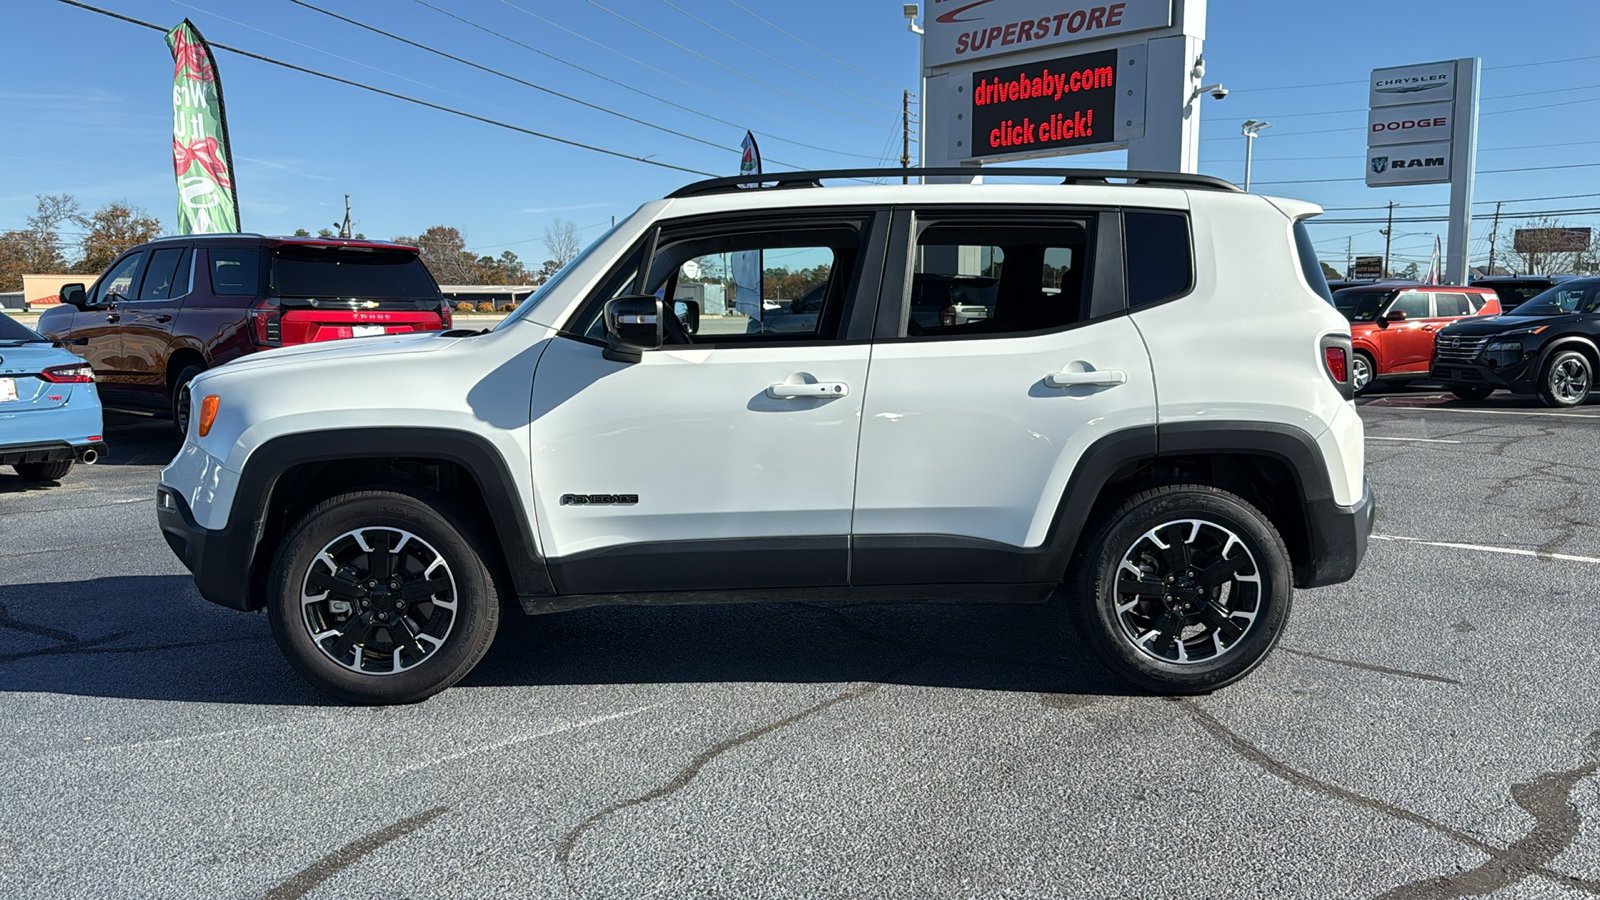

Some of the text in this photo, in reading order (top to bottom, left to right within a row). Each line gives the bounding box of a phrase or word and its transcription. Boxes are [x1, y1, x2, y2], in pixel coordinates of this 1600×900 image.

[955, 2, 1126, 54] SUPERSTORE
[974, 64, 1113, 106] drivebaby.com
[1375, 74, 1447, 87] CHRYSLER
[989, 109, 1093, 148] click click!
[1372, 117, 1447, 132] DODGE
[1391, 157, 1444, 169] RAM
[560, 494, 639, 504] RENEGADE
[450, 586, 479, 660] SUREDRIVE
